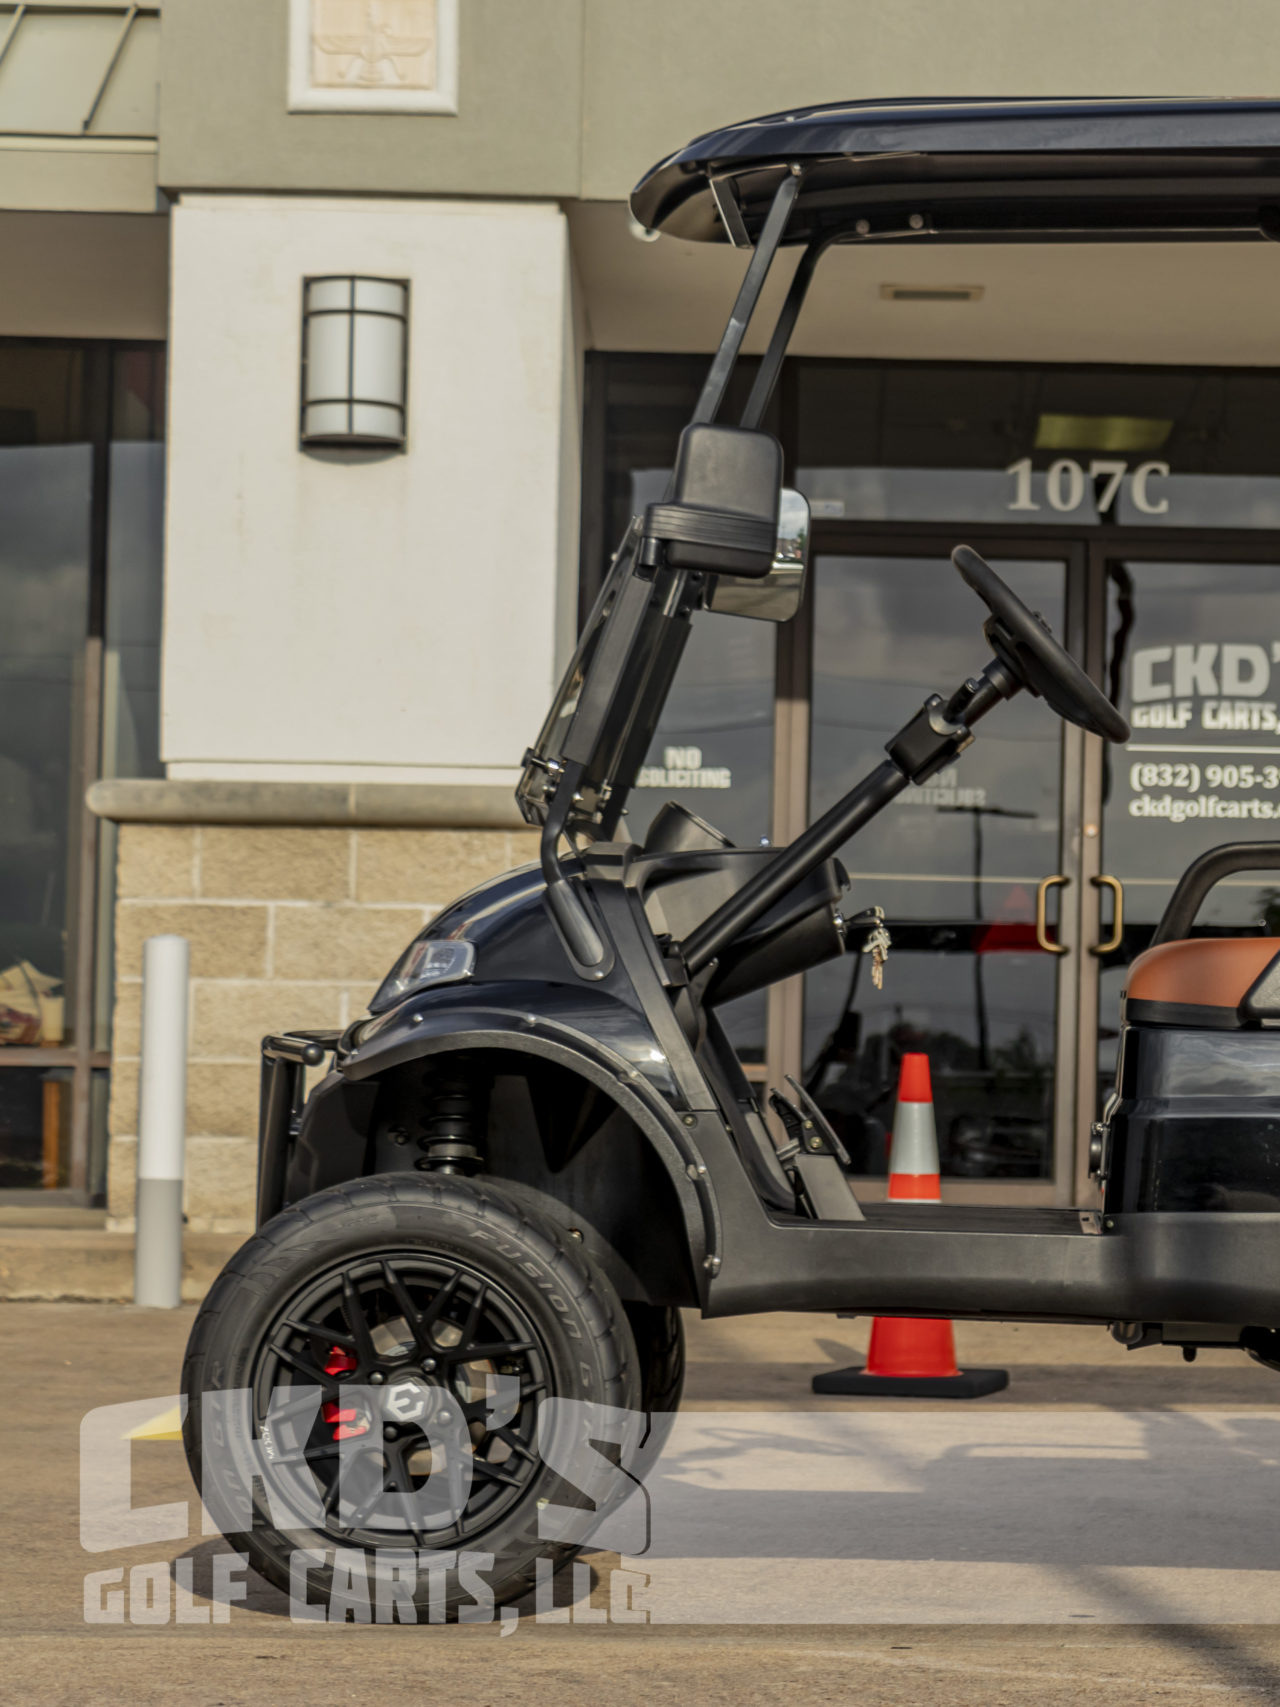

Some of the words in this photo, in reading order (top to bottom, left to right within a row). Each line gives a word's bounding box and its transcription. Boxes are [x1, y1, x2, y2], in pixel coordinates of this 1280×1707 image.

[1006, 457, 1170, 514] 107C
[1131, 701, 1192, 729] GOLF
[664, 746, 702, 770] NO
[635, 766, 731, 788] SOLICITING
[1129, 761, 1200, 792] (832)
